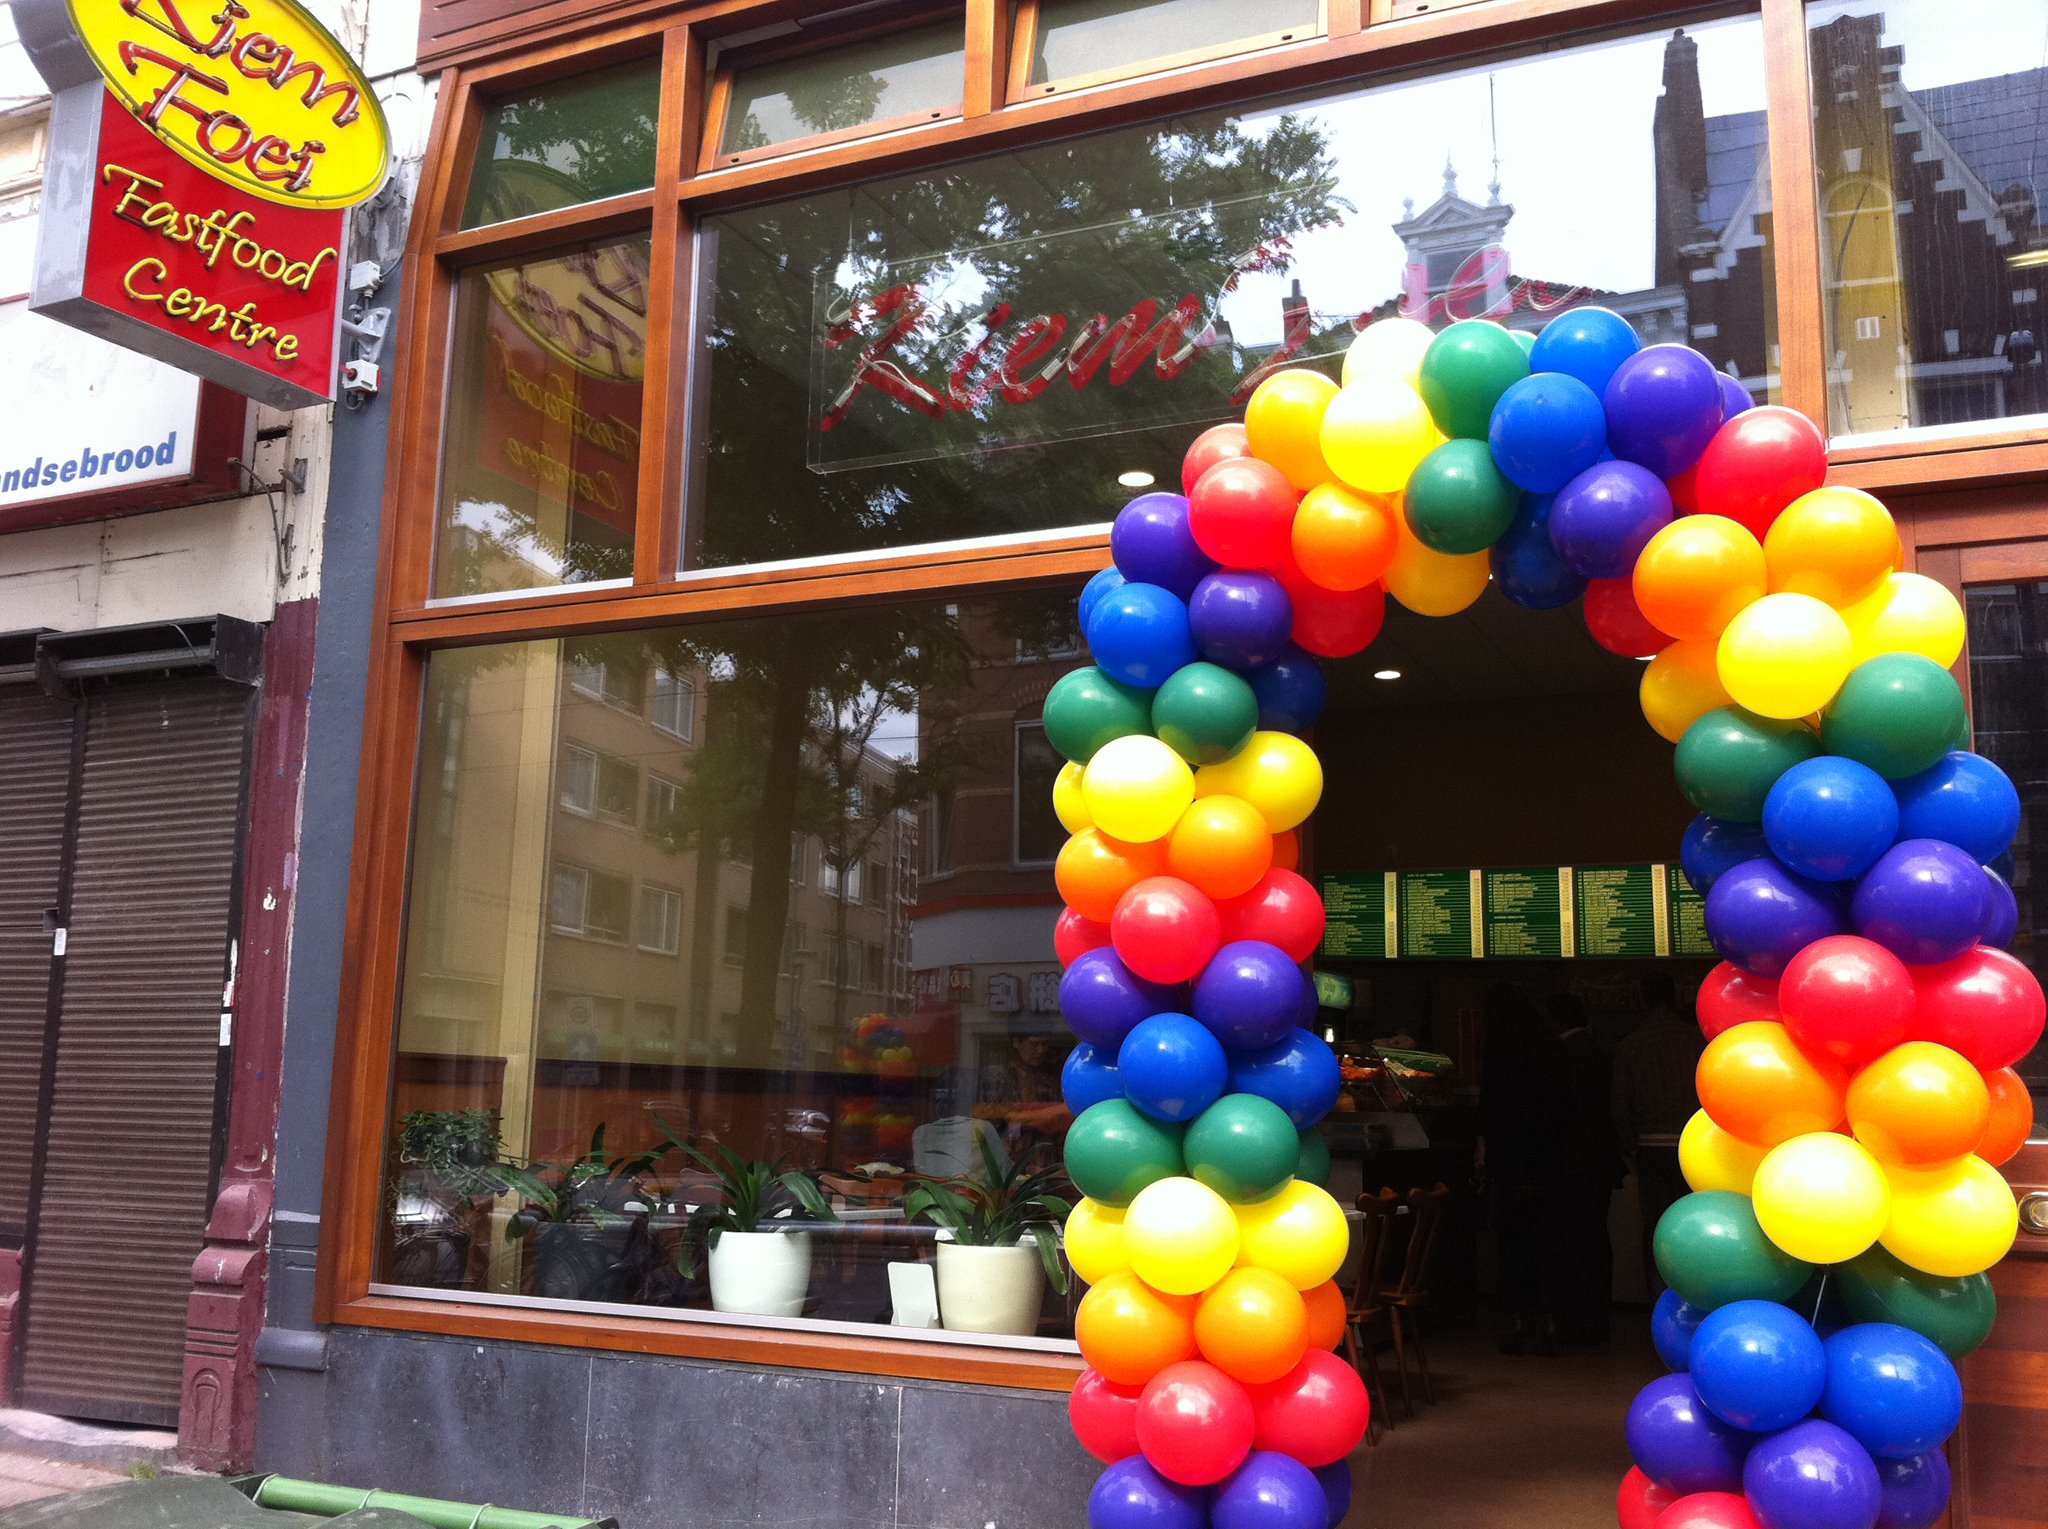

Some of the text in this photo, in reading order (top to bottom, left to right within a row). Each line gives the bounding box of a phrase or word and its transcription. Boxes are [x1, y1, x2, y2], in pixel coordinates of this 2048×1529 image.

[118, 40, 326, 192] Foei
[103, 164, 338, 292] Fastfood
[123, 257, 299, 362] Centre
[0, 431, 177, 493] ndsebrood
